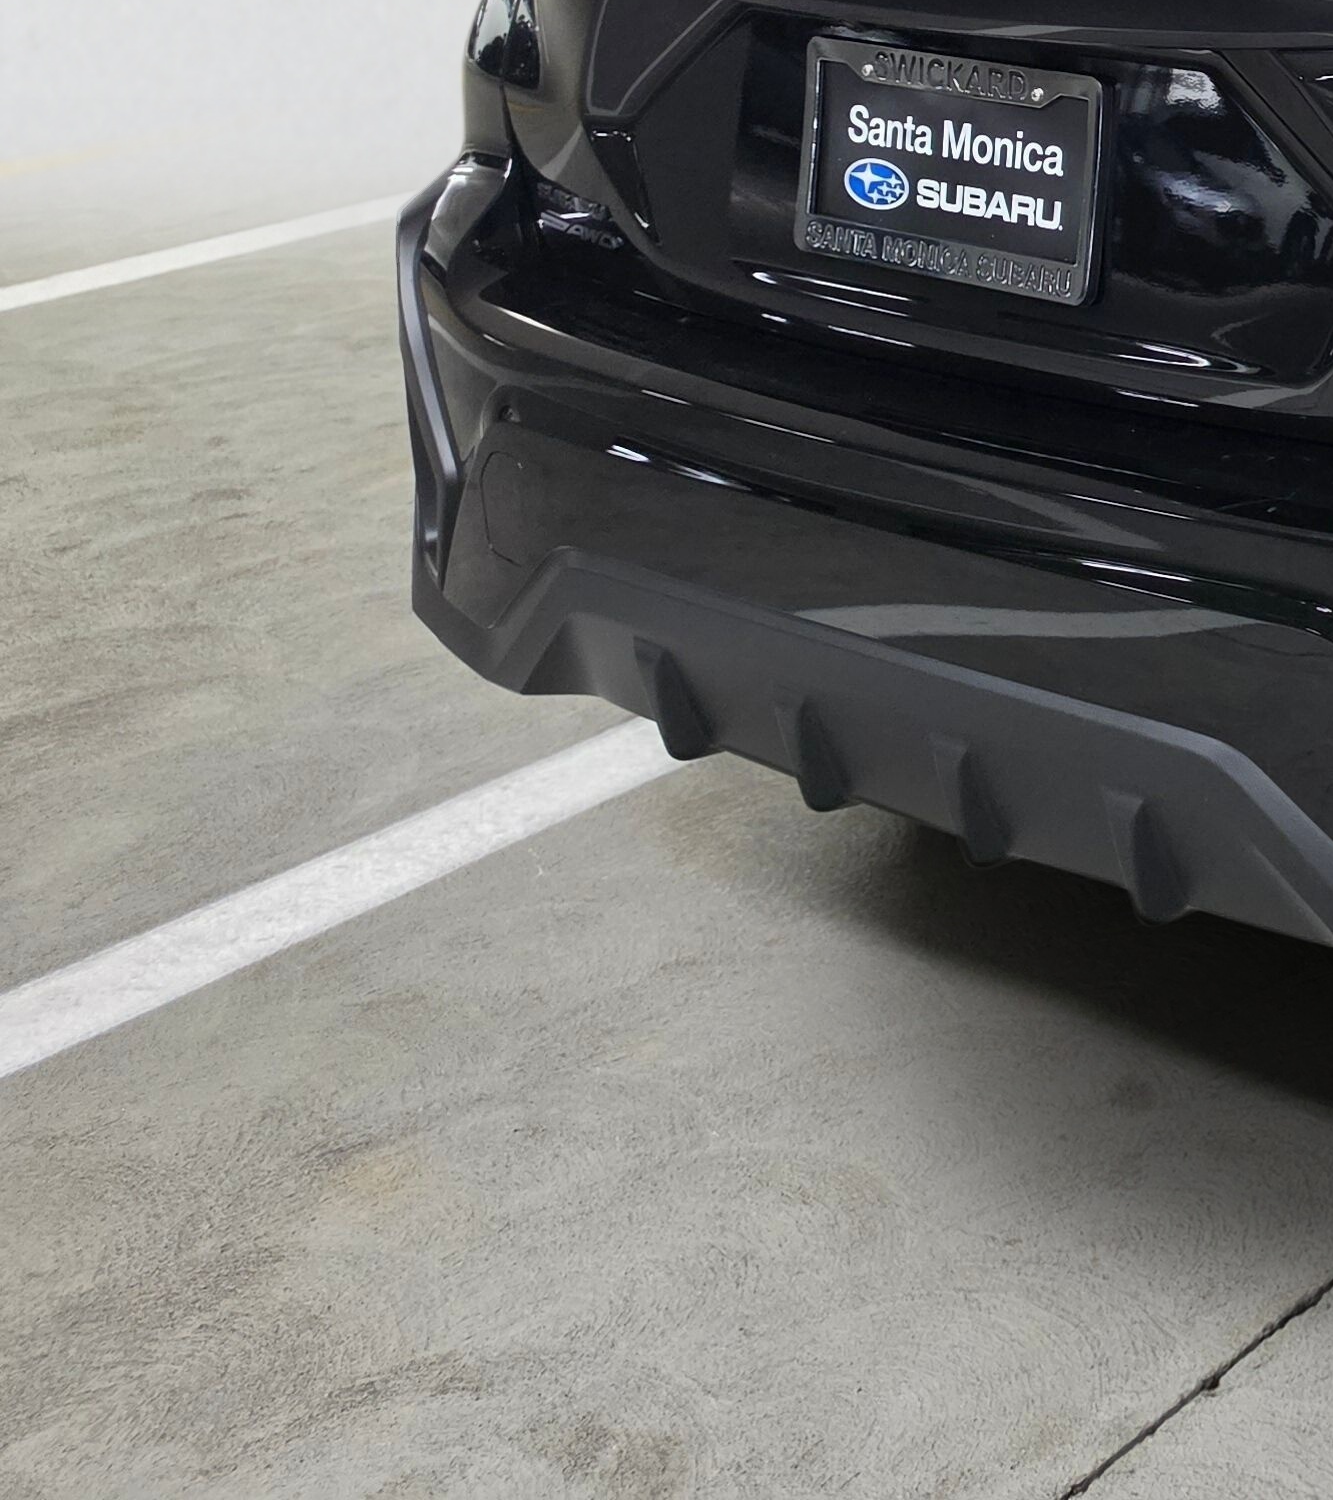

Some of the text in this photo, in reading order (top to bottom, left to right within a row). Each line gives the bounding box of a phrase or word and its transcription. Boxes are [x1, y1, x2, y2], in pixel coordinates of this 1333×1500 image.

[872, 50, 1027, 102] SWICKARD
[847, 104, 1064, 177] Santa Monica
[805, 221, 878, 261] SANTA
[881, 236, 972, 280] MONICA
